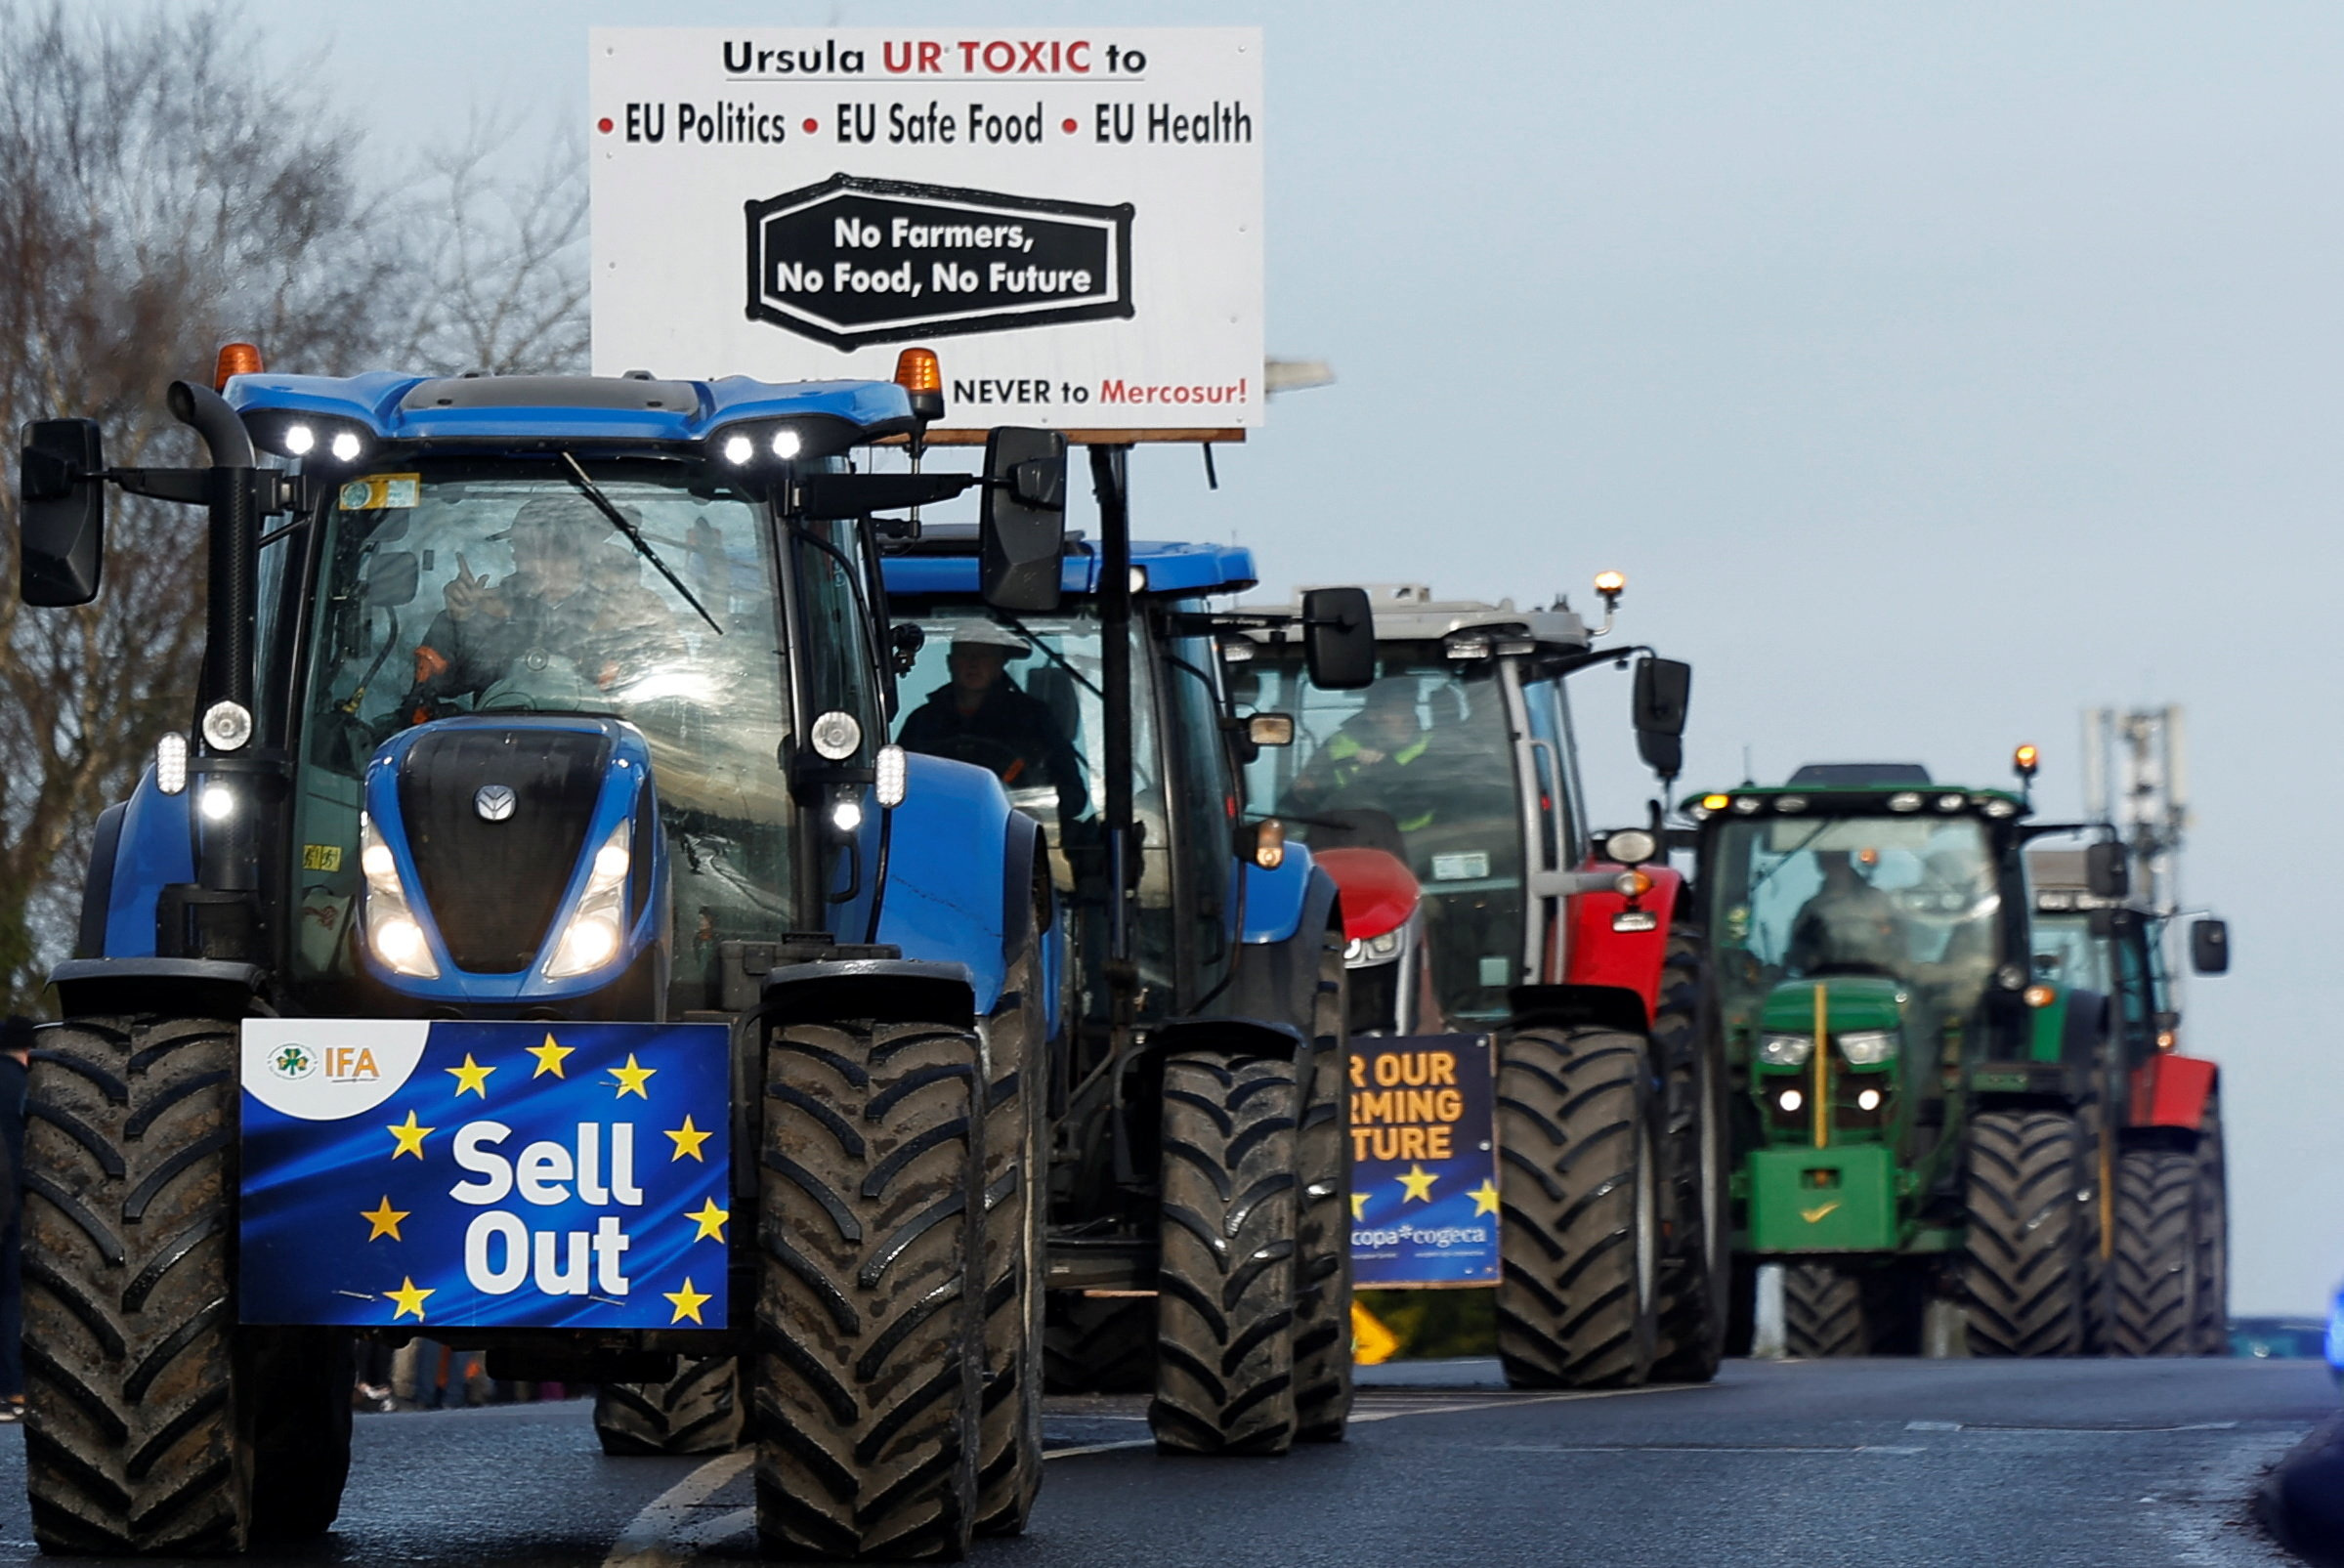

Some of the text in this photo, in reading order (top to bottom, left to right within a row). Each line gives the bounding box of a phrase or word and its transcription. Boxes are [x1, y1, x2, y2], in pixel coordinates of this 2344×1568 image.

[723, 39, 1147, 73] Ursula UR TOXIC to
[626, 101, 1252, 144] EU Politics EU Safe Food EU Health
[834, 218, 1034, 251] No Farmers,
[777, 261, 1091, 298] No Food, No Future
[954, 378, 1246, 403] NEVER to Mercosur!
[325, 1047, 380, 1077] IFA
[1374, 1051, 1456, 1087] OUR
[1351, 1125, 1452, 1162] TURE
[448, 1121, 644, 1207] Sell
[464, 1210, 630, 1296] Out
